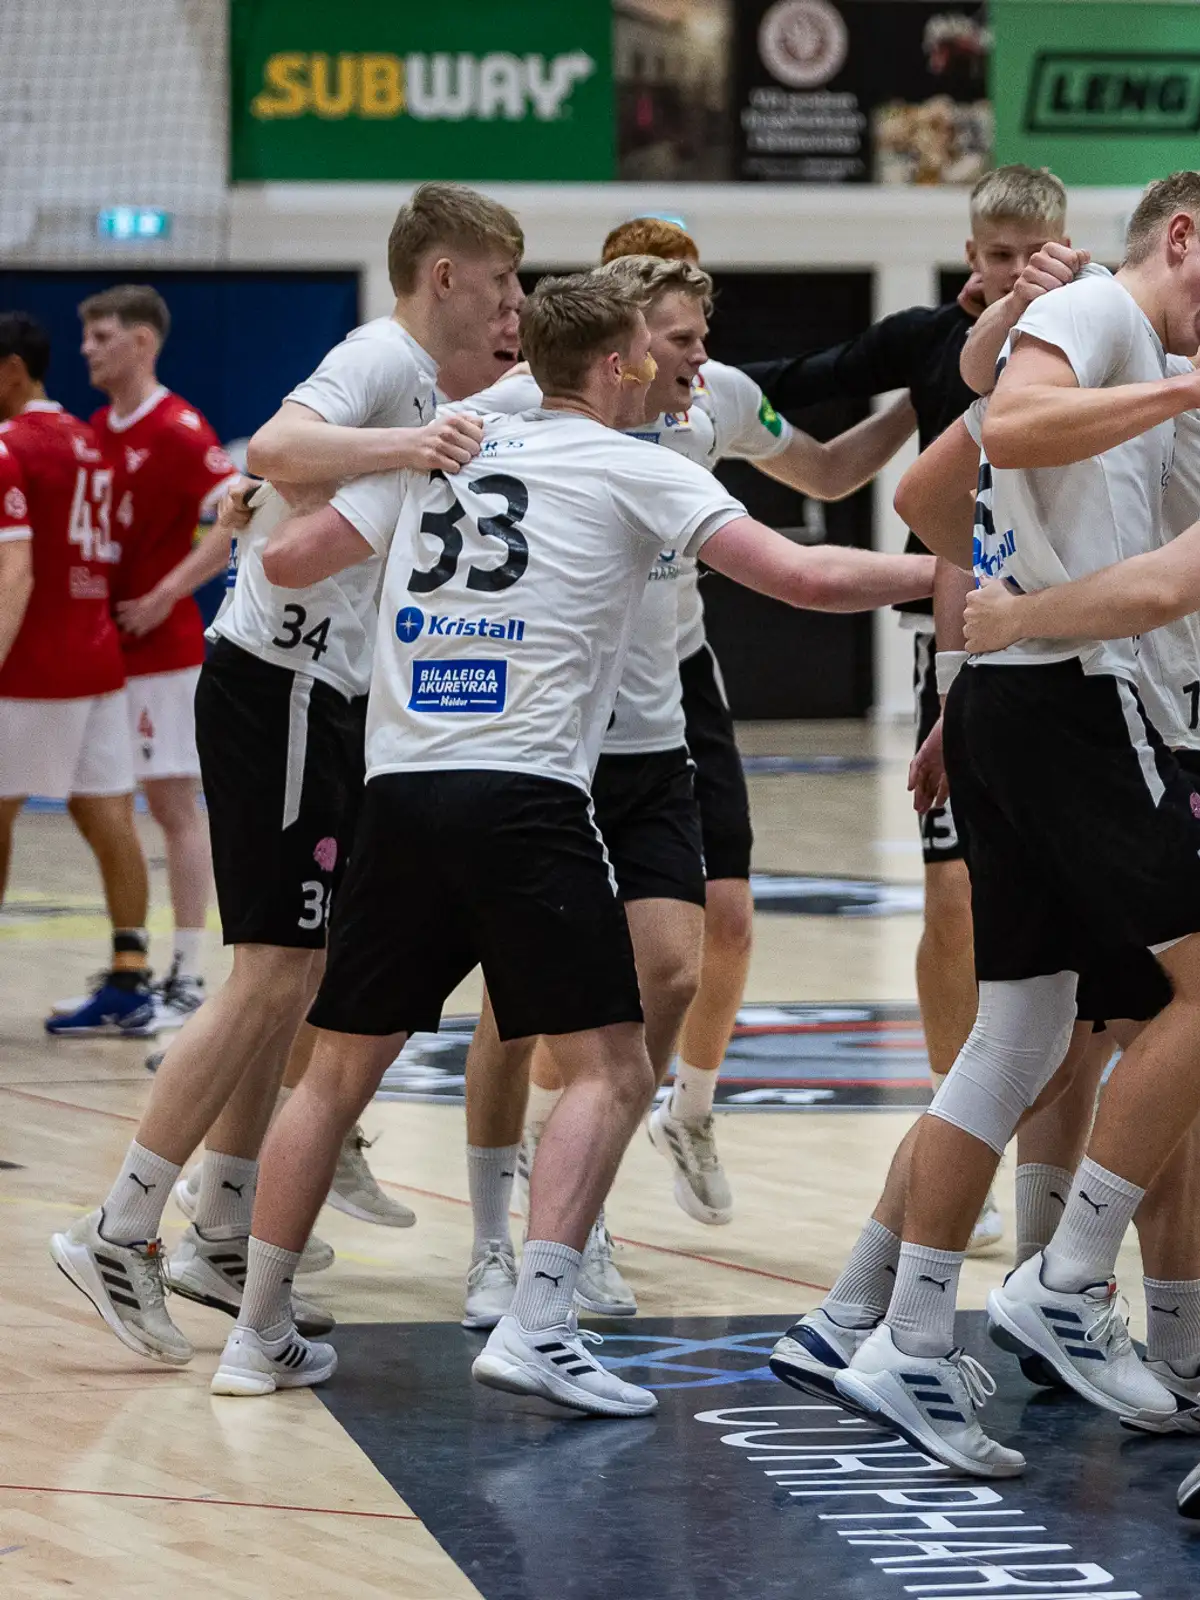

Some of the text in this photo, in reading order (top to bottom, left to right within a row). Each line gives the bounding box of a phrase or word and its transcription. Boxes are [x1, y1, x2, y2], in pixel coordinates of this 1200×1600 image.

[252, 50, 596, 121] SUBWAY
[407, 469, 529, 593] 33
[272, 603, 332, 661] 34
[428, 615, 525, 641] Kristall
[418, 681, 499, 694] AKUREYRAR
[298, 880, 332, 930] 3
